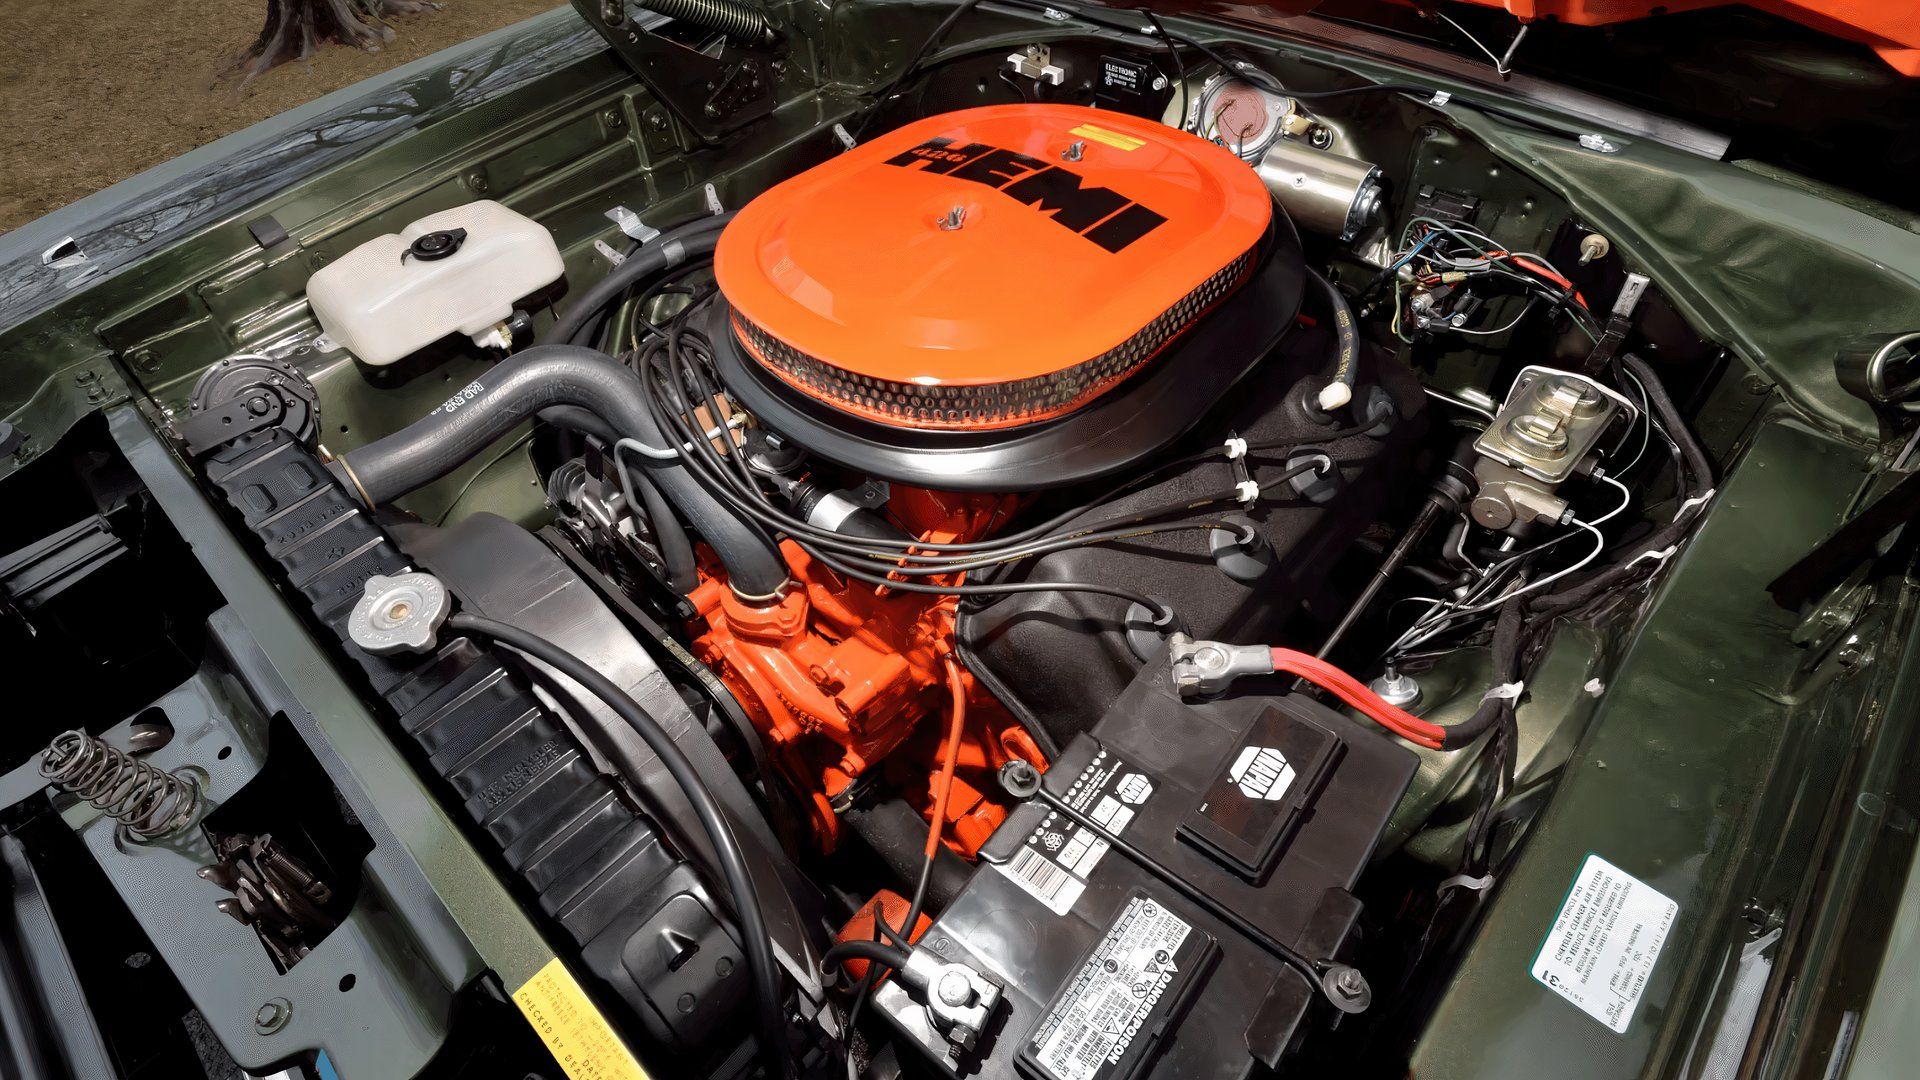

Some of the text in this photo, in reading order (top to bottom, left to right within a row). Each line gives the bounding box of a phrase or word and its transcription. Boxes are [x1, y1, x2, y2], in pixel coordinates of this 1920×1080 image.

[1104, 62, 1137, 77] ELECTRONIC
[882, 136, 1168, 254] HEMI
[446, 395, 466, 412] END
[463, 380, 485, 399] RAD
[1240, 749, 1283, 796] NAPA
[1563, 954, 1574, 967] TO
[518, 991, 553, 1034] CHECKED
[1105, 970, 1173, 1065] DANGER/POISON
